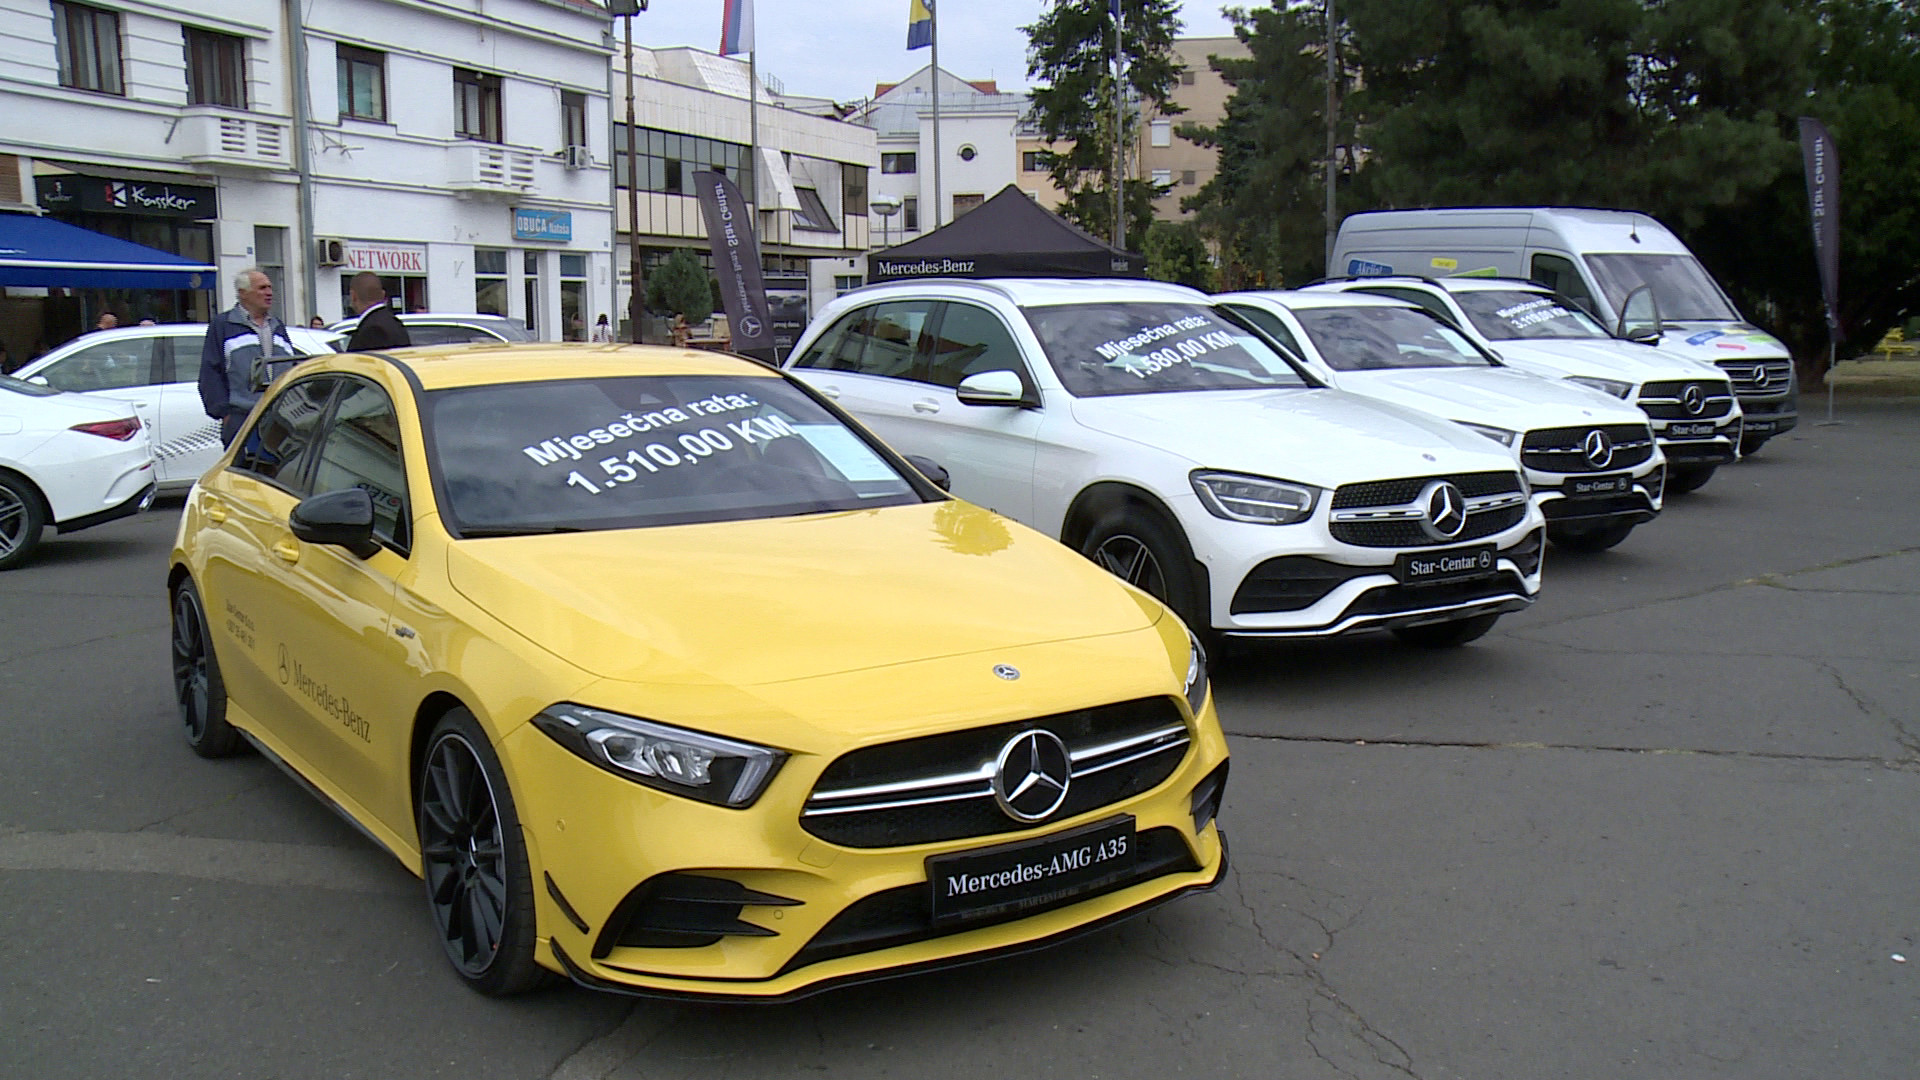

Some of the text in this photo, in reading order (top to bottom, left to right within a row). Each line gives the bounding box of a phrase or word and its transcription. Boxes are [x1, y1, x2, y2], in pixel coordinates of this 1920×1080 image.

[131, 185, 196, 210] Kassker
[517, 215, 547, 232] OBUĆA
[346, 249, 422, 271] NETWORK
[878, 259, 975, 275] Mercedes-Benz
[1095, 314, 1212, 360] Mjesečna rata:
[1125, 330, 1240, 380] 1.580,00 KM
[523, 391, 760, 467] Mjesečna rata:
[566, 413, 801, 495] 1.510,00 KM
[1411, 556, 1477, 576] Star-Centar
[293, 659, 372, 744] Mercedes-Benz
[946, 836, 1127, 897] Mercedes-AMG A35
